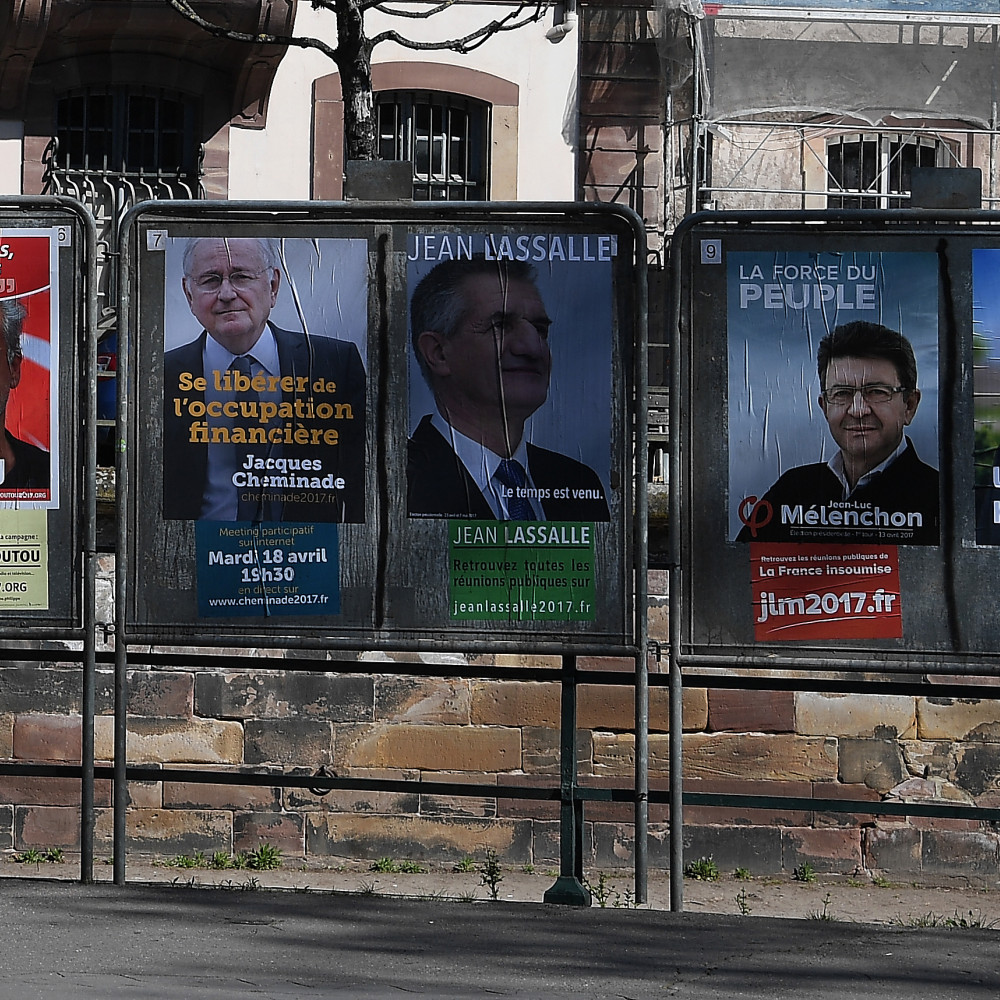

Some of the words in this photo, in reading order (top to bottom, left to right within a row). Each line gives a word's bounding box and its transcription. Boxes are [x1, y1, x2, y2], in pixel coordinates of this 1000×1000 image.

[57, 227, 66, 242] 6
[152, 234, 162, 248] 7
[407, 235, 473, 261] JEAN
[484, 235, 611, 262] LASSALLE
[706, 244, 716, 259] 9
[739, 265, 764, 280] LA
[772, 265, 838, 280] FORCE
[847, 265, 876, 281] DU
[740, 283, 876, 310] PEUPLE
[178, 372, 207, 391] Se
[212, 370, 309, 392] libérer
[312, 378, 337, 393] de
[188, 421, 339, 445] financière
[242, 454, 322, 474] Jacques
[231, 471, 346, 489] Cheminade
[241, 492, 336, 504] cheminade2017.fr
[501, 484, 514, 498] Le
[516, 486, 550, 502] temps
[553, 488, 570, 499] est
[572, 489, 604, 500] venu.
[827, 500, 872, 509] Jean-Luc
[781, 504, 923, 527] Mélenchon
[219, 527, 259, 538] Meeting
[261, 525, 315, 537] participatif
[453, 526, 497, 544] JEAN
[504, 526, 590, 544] LASSALLE
[256, 537, 295, 546] internet
[208, 549, 258, 566] Mardi
[262, 549, 284, 564] 18
[287, 548, 328, 563] avril
[842, 553, 878, 561] publiques
[879, 552, 889, 560] de
[453, 559, 518, 572] Retrouvez
[525, 559, 564, 572] toutes
[571, 558, 590, 571] les
[759, 566, 775, 577] La
[778, 565, 823, 576] France
[826, 563, 892, 575] insoumise
[241, 566, 295, 582] 19h30
[238, 587, 250, 595] en
[253, 585, 281, 594] diect
[283, 585, 299, 594] sur
[453, 575, 505, 587] réunions
[509, 575, 568, 590] publiques
[571, 577, 590, 588] sur
[453, 600, 591, 616] jeanlassalle2017.fr
[757, 588, 896, 623] jlm2017.fr
